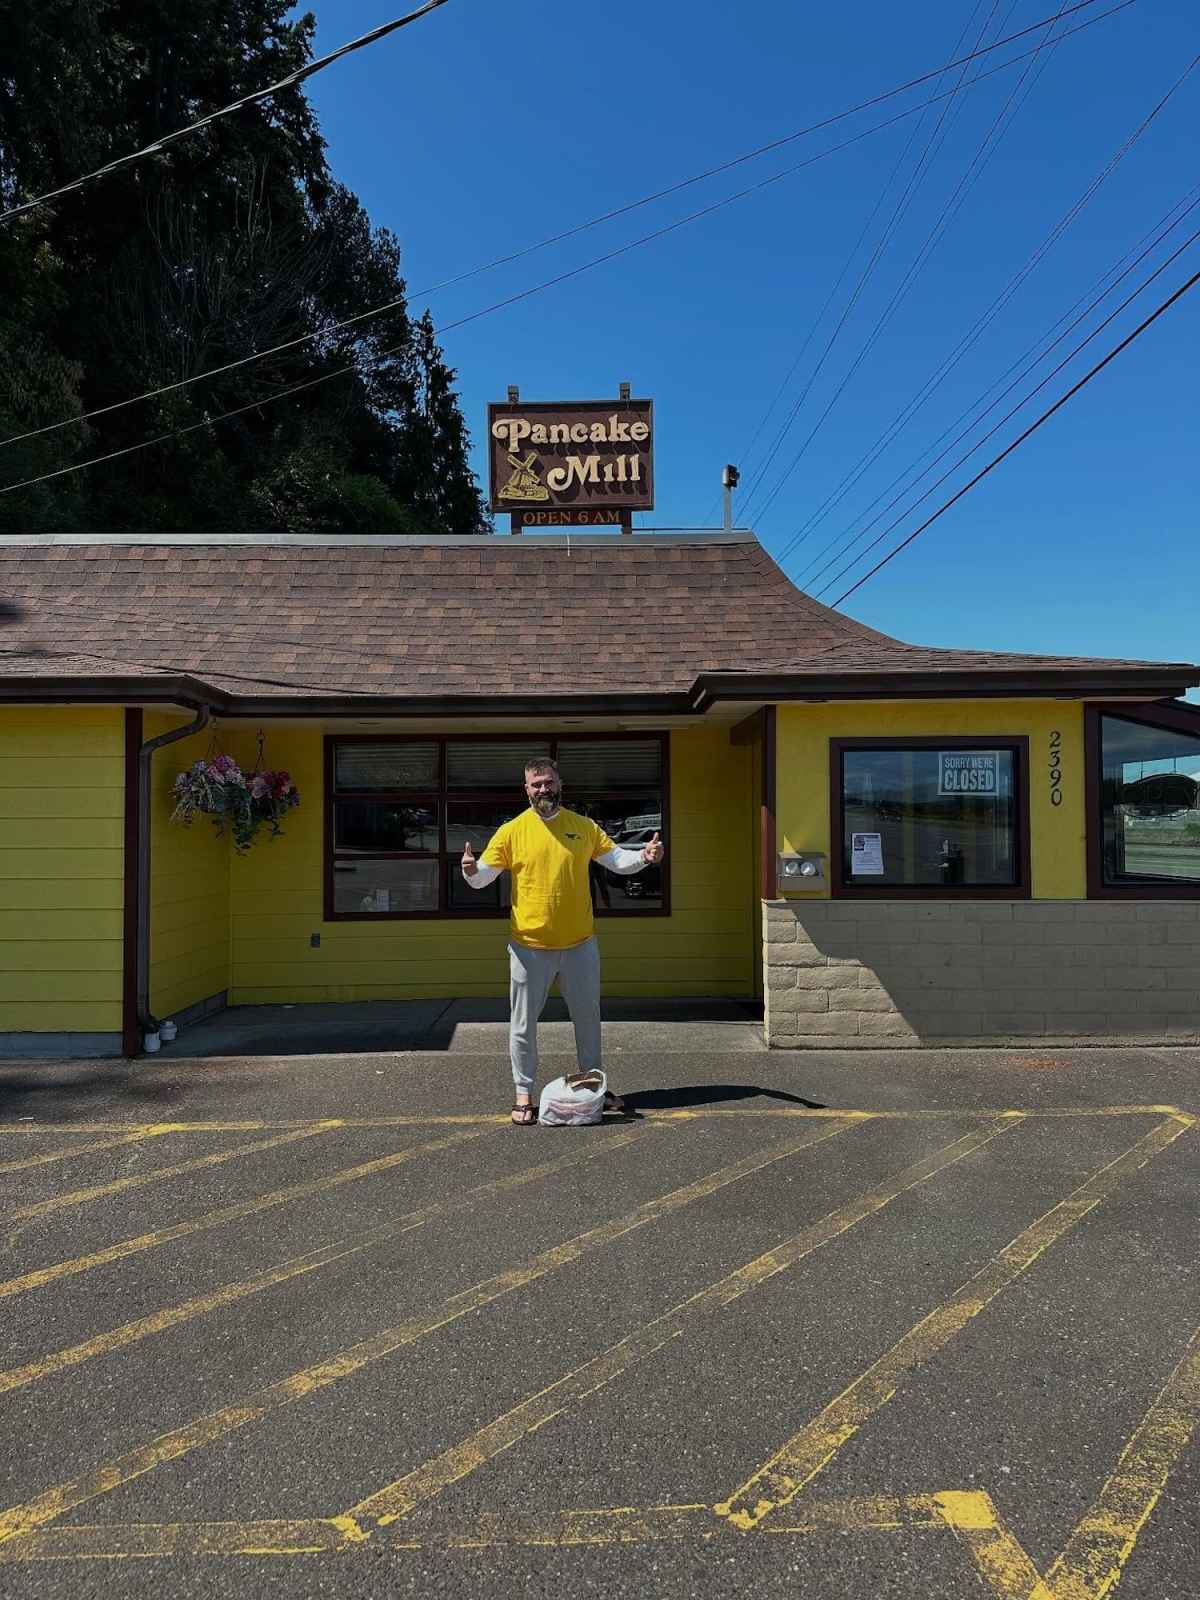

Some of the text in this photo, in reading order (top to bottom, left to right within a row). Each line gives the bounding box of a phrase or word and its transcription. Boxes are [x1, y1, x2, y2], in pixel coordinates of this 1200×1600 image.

[492, 414, 649, 452] Pancake
[547, 454, 640, 491] Mill
[523, 510, 620, 525] OPEN 6 AM
[944, 757, 970, 769] SORRY
[1048, 730, 1062, 806] 2390
[944, 769, 994, 790] CLOSED
